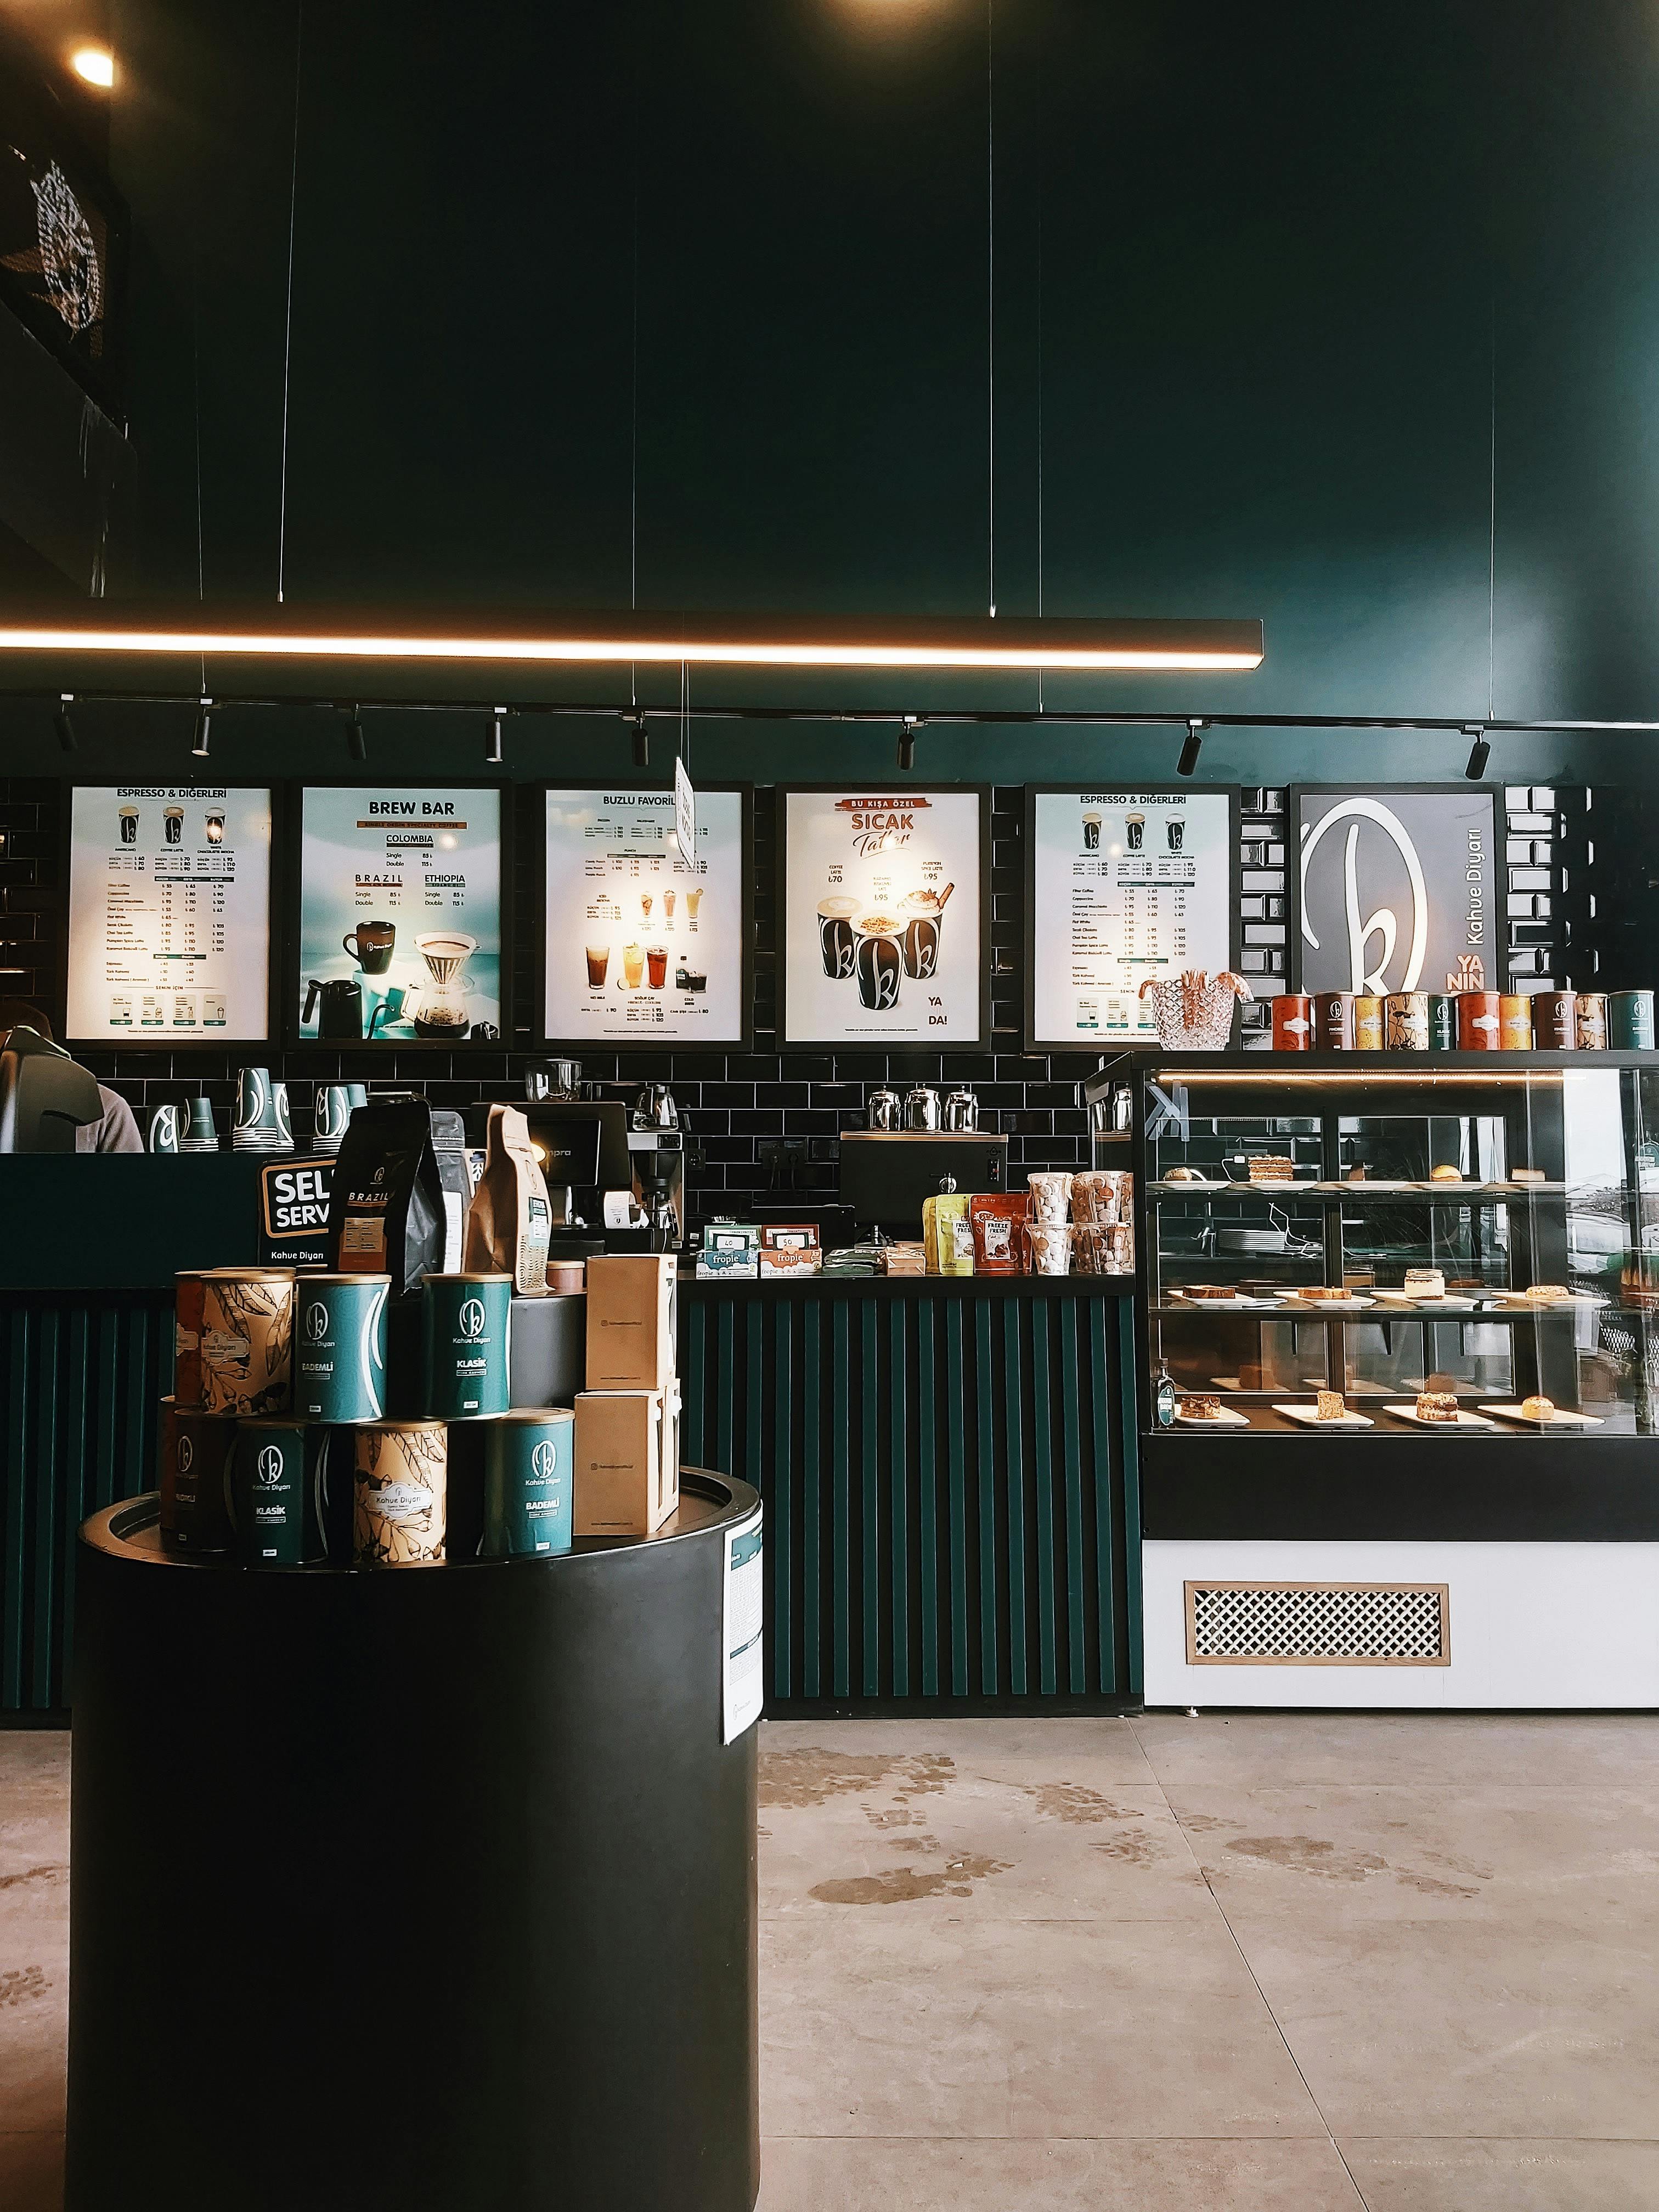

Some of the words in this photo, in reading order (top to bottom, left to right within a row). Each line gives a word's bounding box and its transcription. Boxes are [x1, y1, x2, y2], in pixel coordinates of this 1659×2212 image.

[117, 788, 165, 798] ESPRESSO
[168, 789, 176, 798] &
[603, 796, 635, 805] BUZLU
[637, 795, 675, 805] FAVORİL
[1080, 795, 1127, 804] ESPRESSO
[369, 802, 416, 815] BREW
[422, 803, 454, 815] BAR
[852, 814, 913, 830] SICAK
[1467, 887, 1484, 945] Kahve
[1457, 955, 1484, 972] YA
[1447, 973, 1484, 990] NIN
[928, 996, 943, 1006] YA
[928, 1015, 948, 1025] DA!
[275, 1170, 335, 1203] SEL
[349, 1193, 388, 1201] BRAZIL
[276, 1203, 329, 1227] SERV
[271, 1251, 297, 1260] Kahve
[457, 1357, 487, 1368] KLASİK
[256, 1505, 286, 1515] KLASİK
